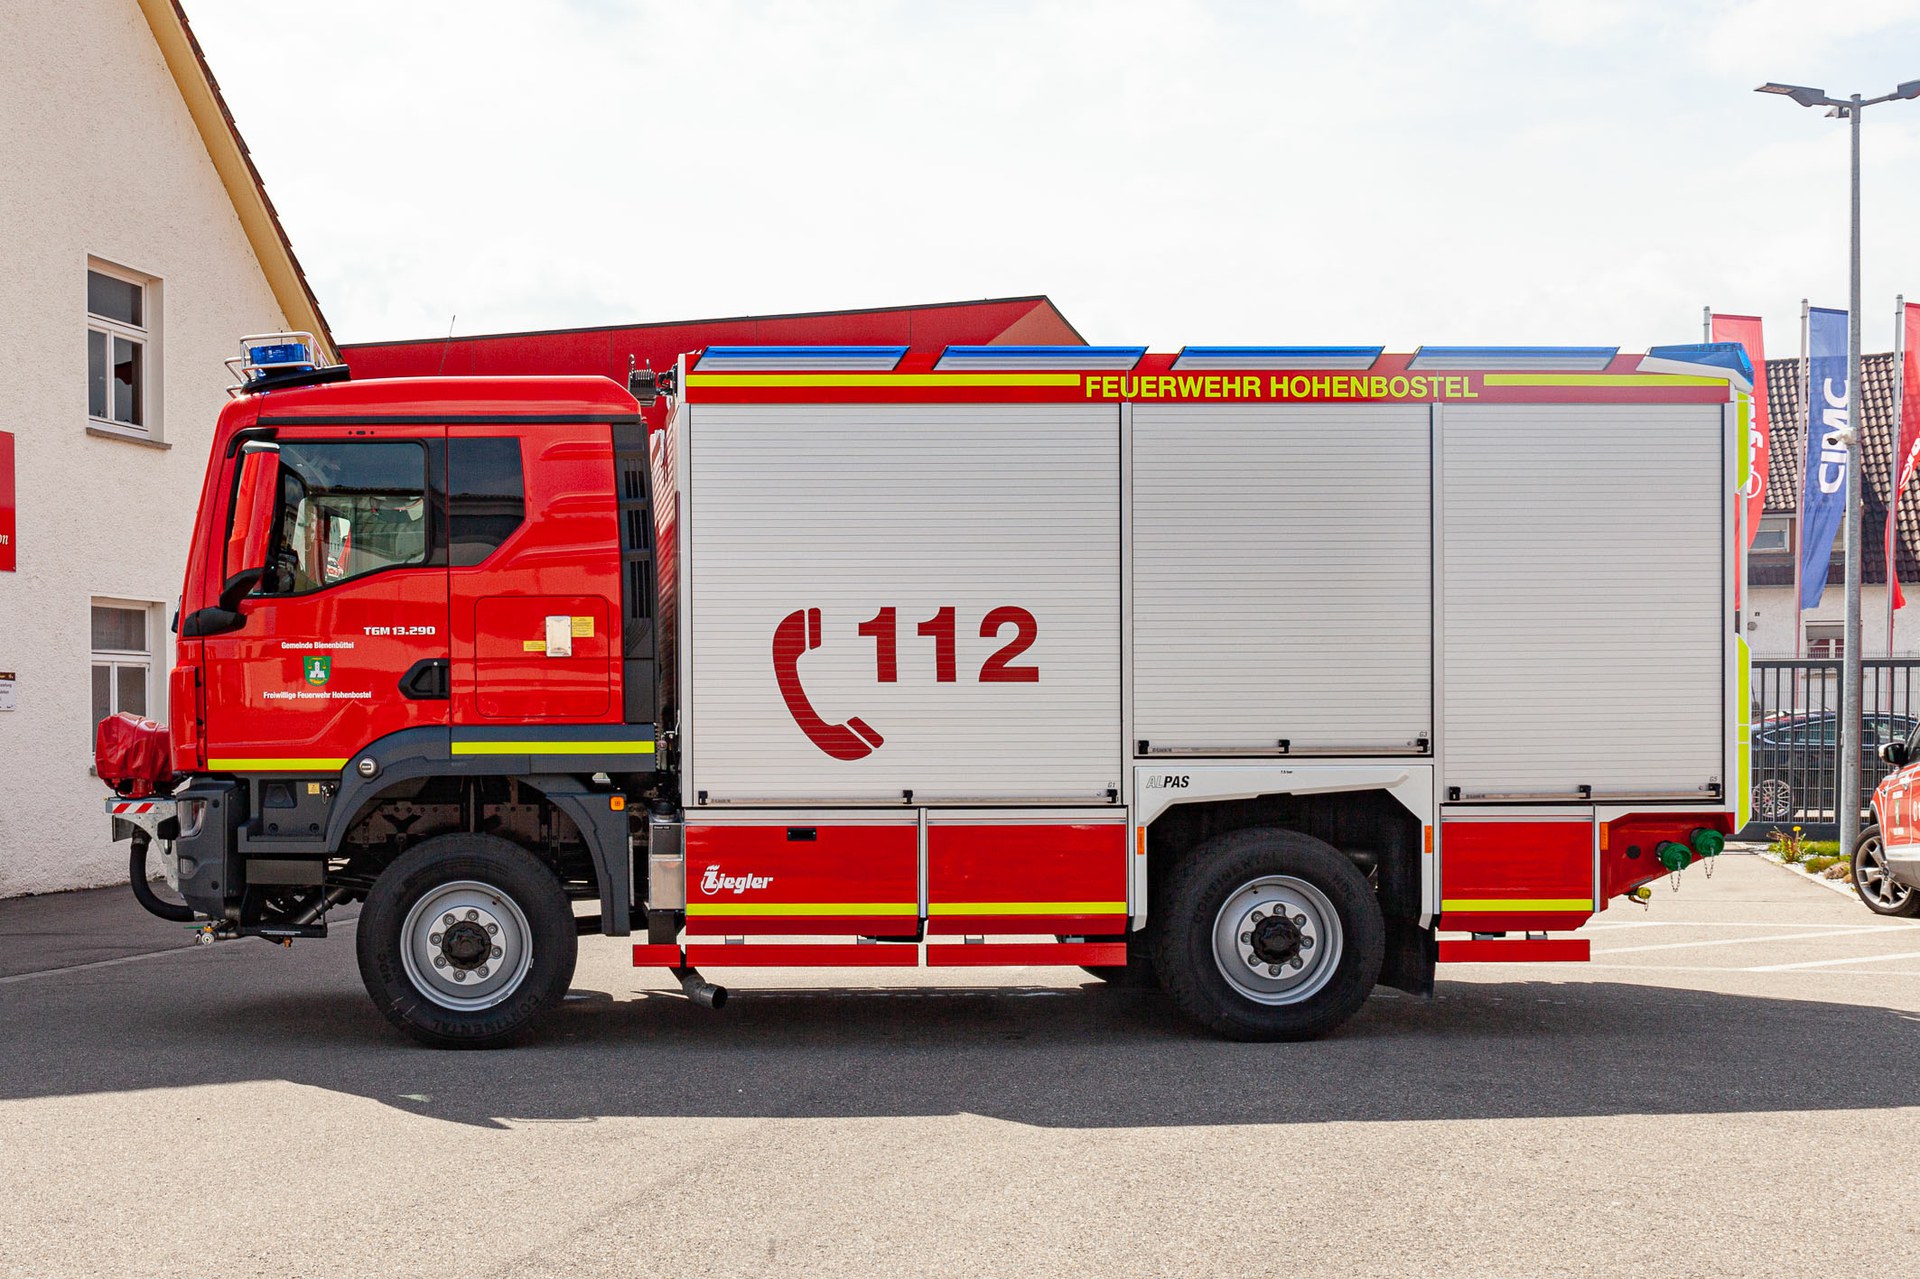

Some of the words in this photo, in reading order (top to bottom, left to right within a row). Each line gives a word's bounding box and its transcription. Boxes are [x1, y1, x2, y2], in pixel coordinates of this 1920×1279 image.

[1086, 375, 1261, 399] FEUERWEHR
[1269, 375, 1479, 399] HOHENBOSTEL
[1818, 378, 1848, 494] CIMC
[363, 626, 390, 636] TGM
[392, 626, 436, 635] 13.290
[281, 641, 313, 649] Gemeinde
[314, 641, 355, 649] Bienenbüttel
[857, 606, 1040, 683] 112
[263, 691, 297, 700] Freiwillige
[297, 691, 331, 699] Feuerwehr
[332, 691, 372, 699] Hohenbostel
[1146, 775, 1190, 788] ALPAS
[701, 865, 774, 895] Ziegler
